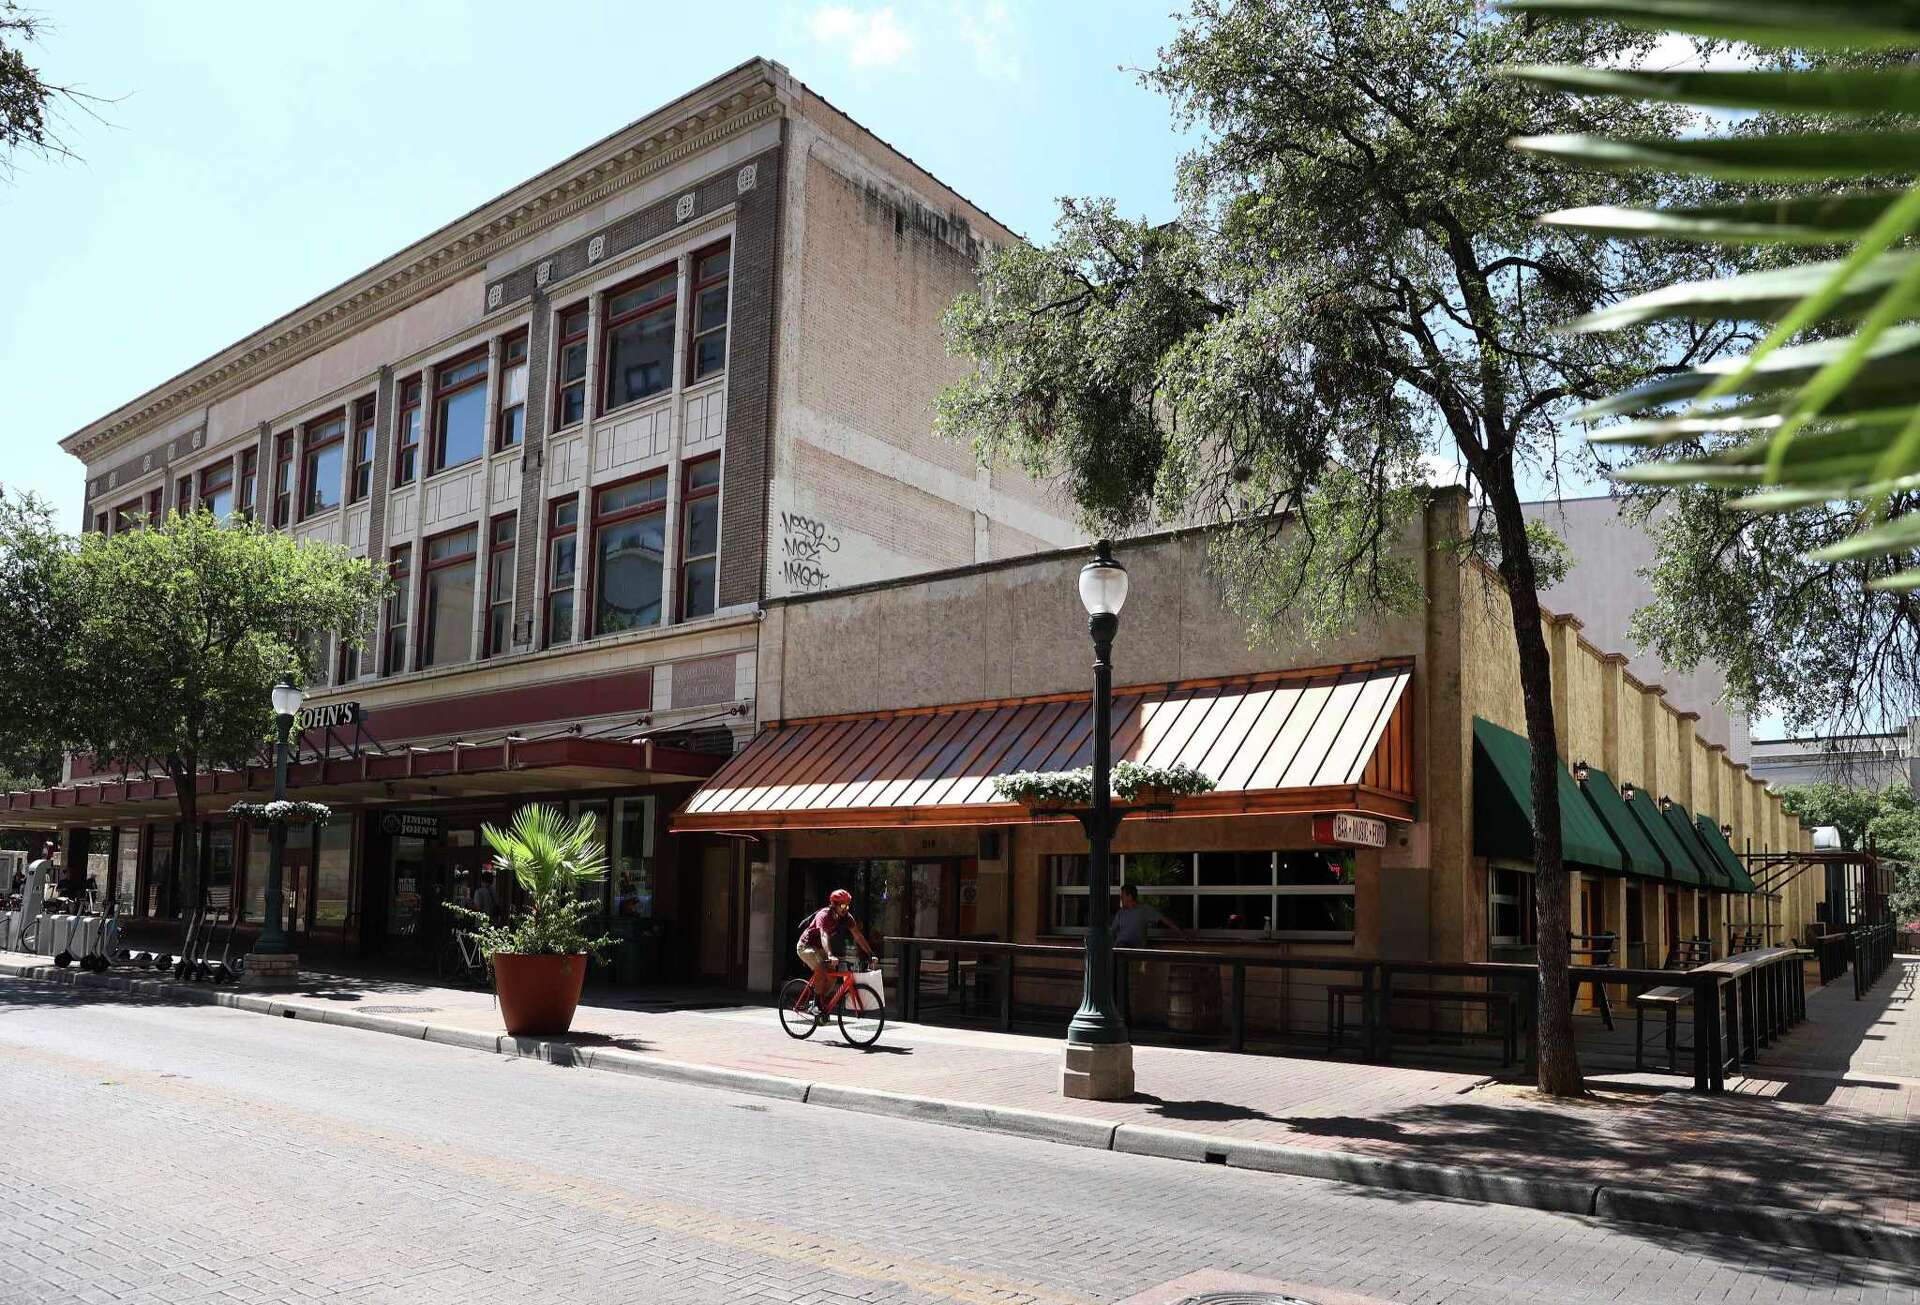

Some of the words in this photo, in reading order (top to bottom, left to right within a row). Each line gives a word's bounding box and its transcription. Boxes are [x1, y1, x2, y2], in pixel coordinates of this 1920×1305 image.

[301, 702, 353, 730] OHN'S
[401, 815, 438, 826] JIMMY
[1337, 815, 1347, 838] BAR
[1352, 819, 1368, 842] MUSIC
[1372, 823, 1384, 845] FOOD
